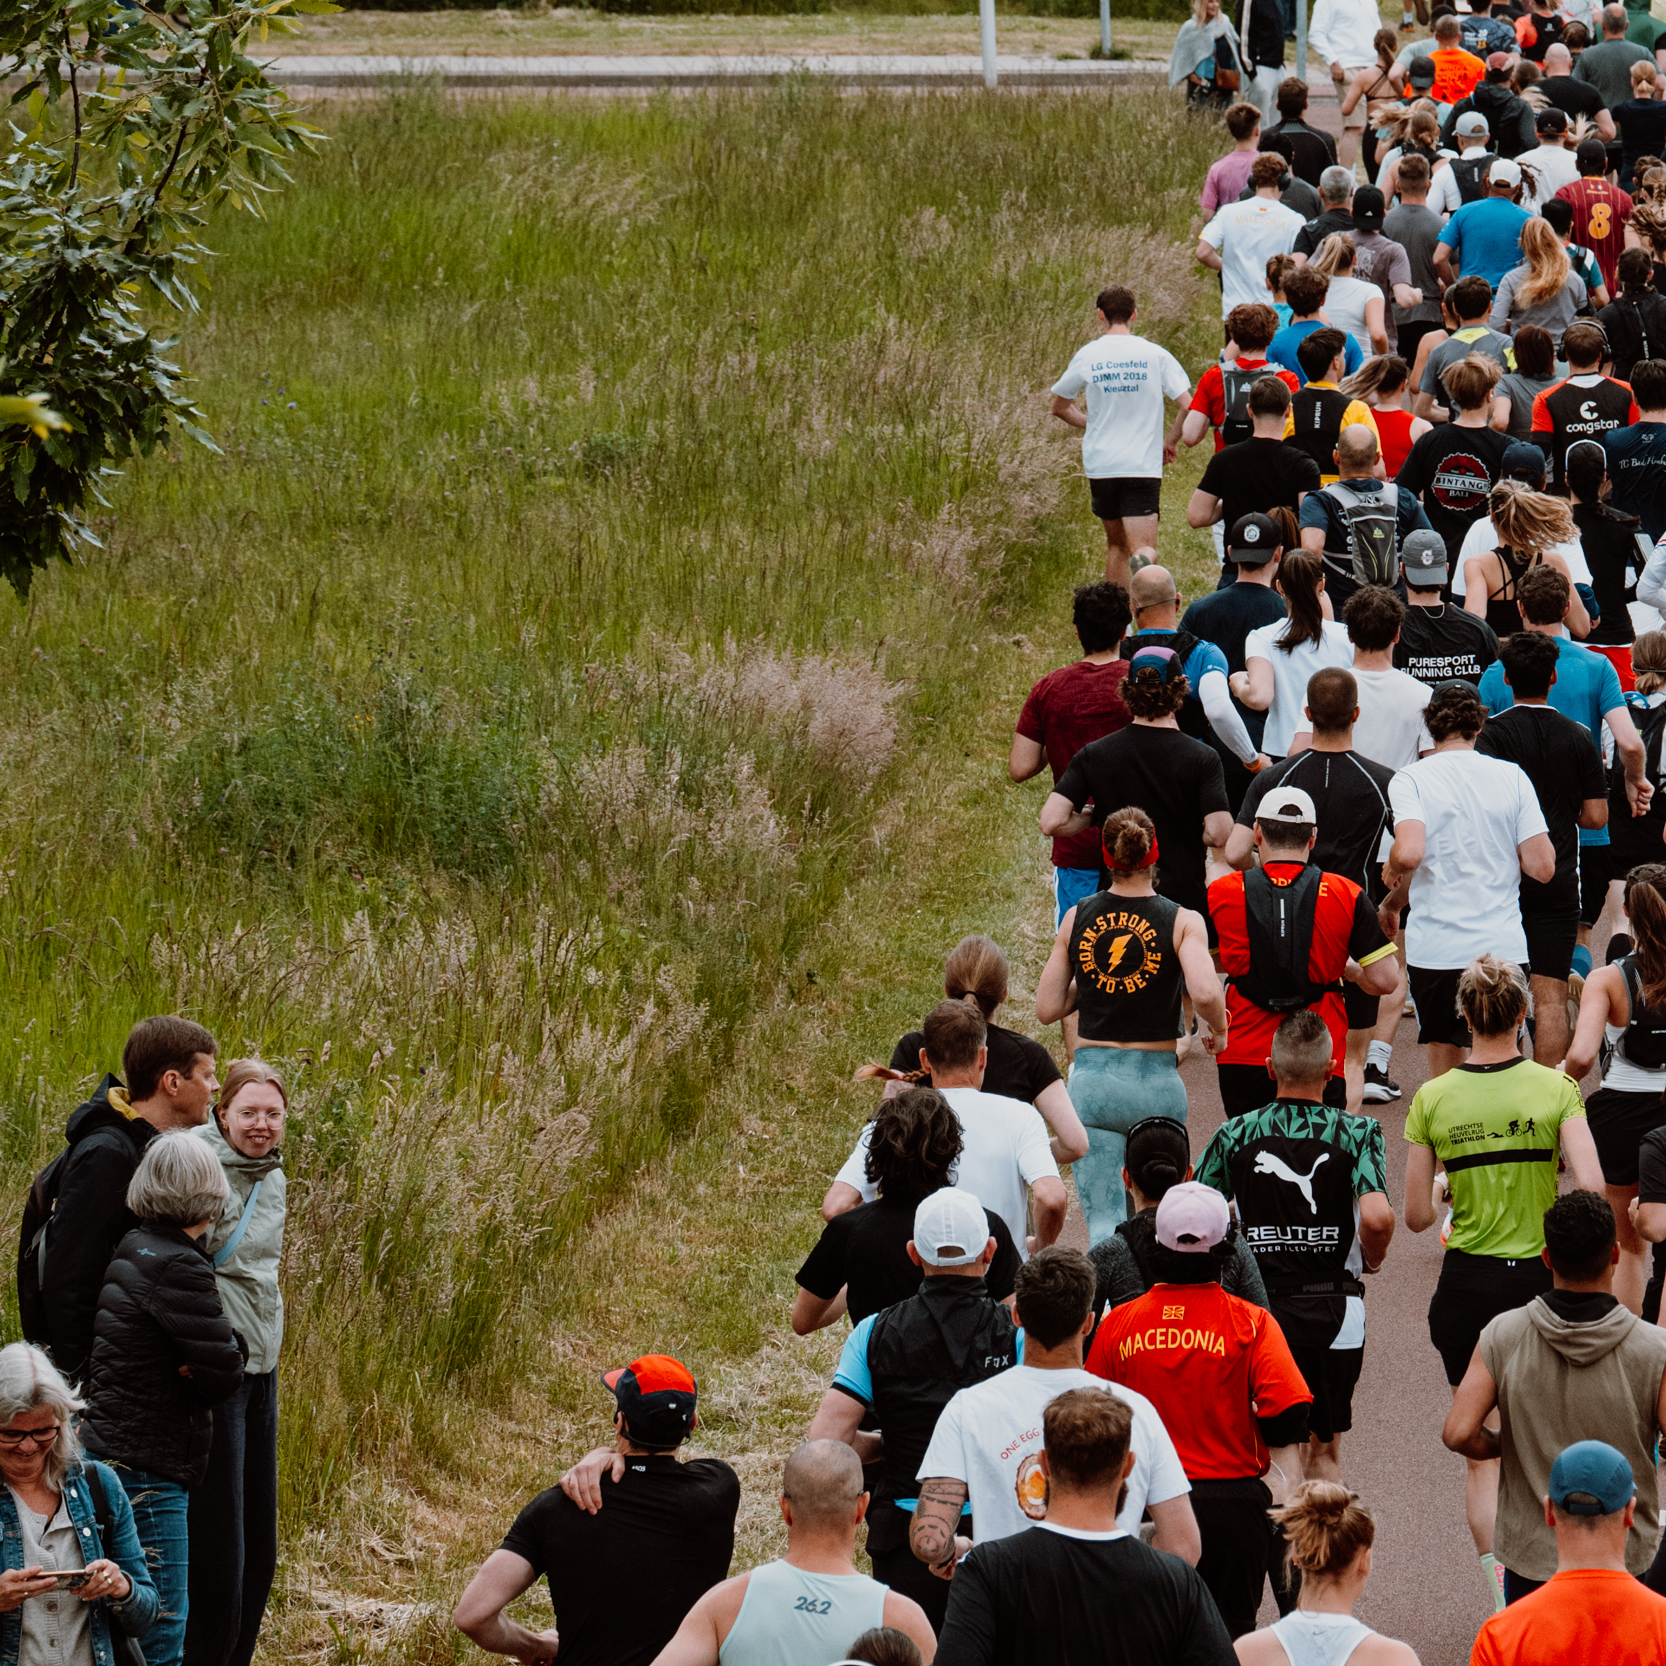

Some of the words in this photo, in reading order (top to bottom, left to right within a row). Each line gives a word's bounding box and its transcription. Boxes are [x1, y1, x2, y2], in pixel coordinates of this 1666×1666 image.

[1235, 214, 1295, 232] MACEDONIA
[1589, 203, 1612, 240] 8
[1091, 362, 1104, 372] LG
[1106, 361, 1148, 370] Coesfeld
[1092, 372, 1122, 383] DJMM
[1123, 371, 1148, 381] 2018
[1314, 401, 1322, 429] KIPRUN
[1566, 419, 1620, 435] congstar
[1449, 489, 1470, 498] BALI
[1409, 654, 1476, 667] PURESPORT
[1096, 912, 1156, 941] STRONG
[1079, 928, 1099, 972] BORN
[1146, 951, 1162, 975] ME
[1096, 974, 1115, 993] TO
[1126, 974, 1147, 993] BE
[1447, 1122, 1484, 1134] UTRECHTSE
[1448, 1128, 1486, 1140] HEUVELRUG
[1450, 1134, 1486, 1147] TRIATHLON
[1247, 1226, 1340, 1241] REUTER
[1120, 1327, 1226, 1362] MACEDONIA
[1000, 1441, 1022, 1460] ONE
[1020, 1427, 1041, 1443] EGG
[794, 1596, 832, 1615] 26.2
